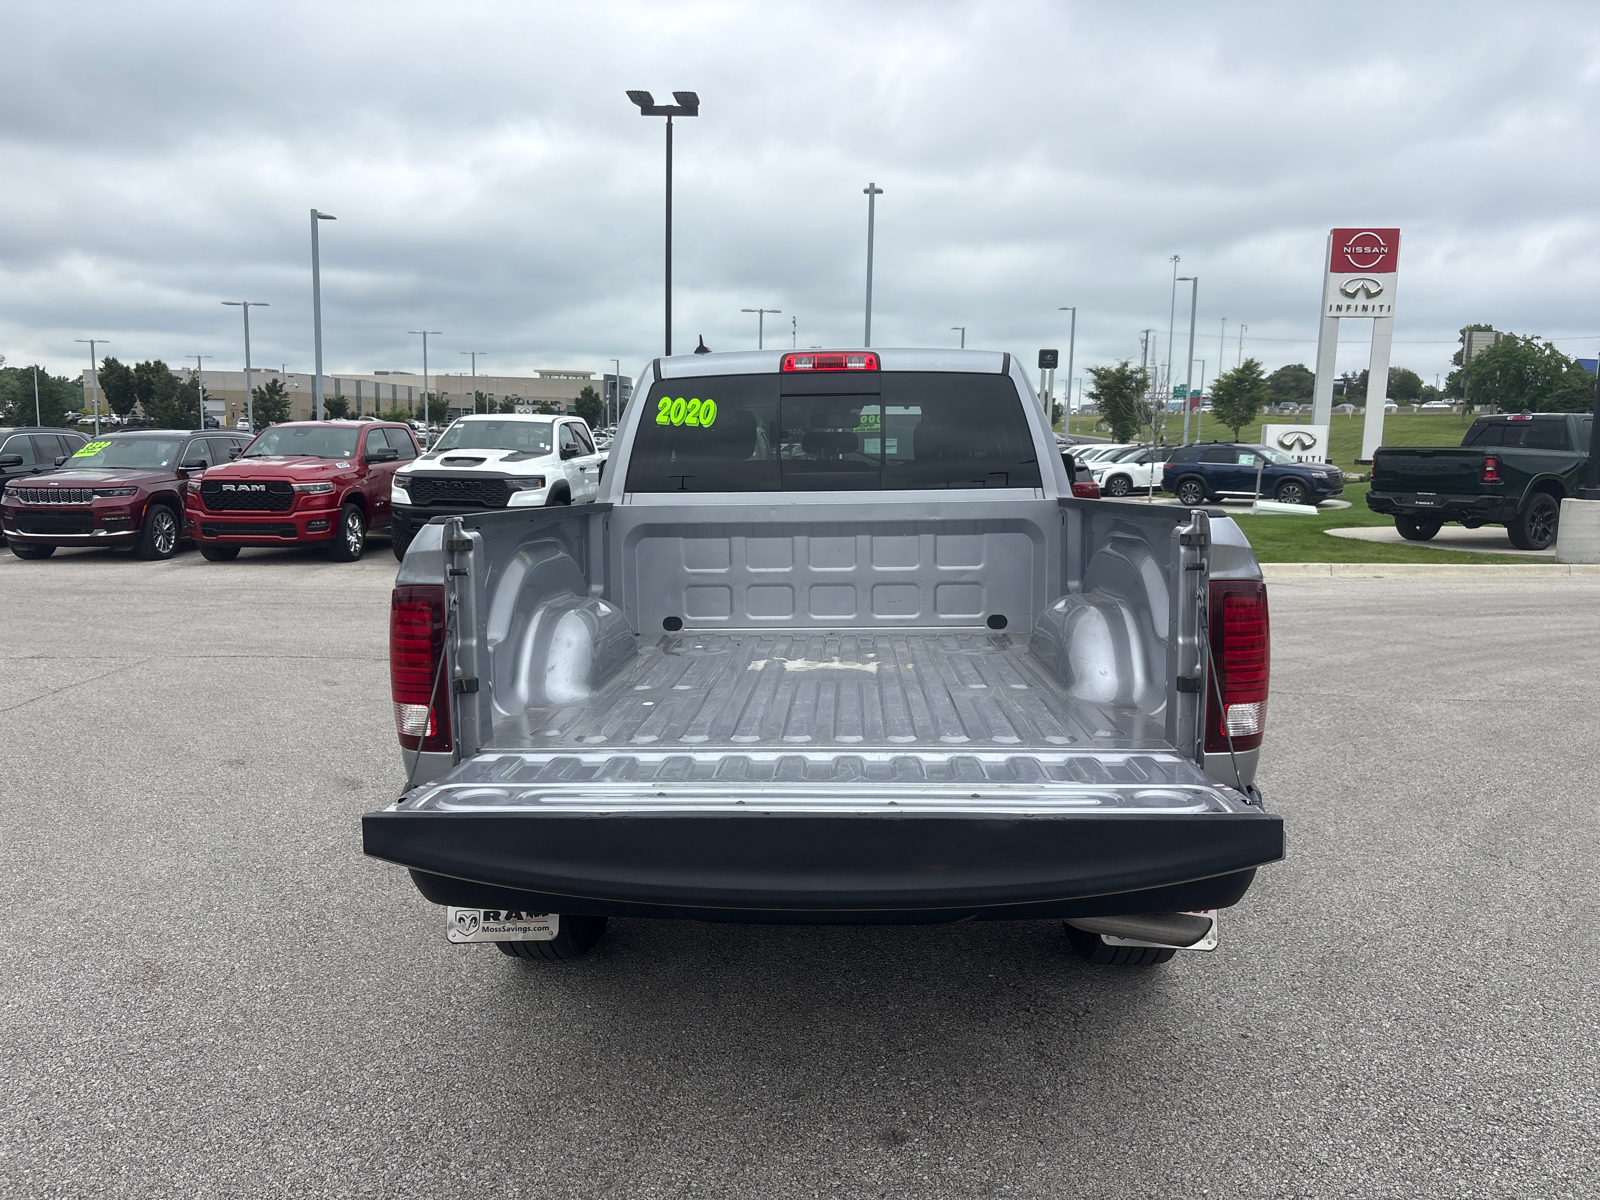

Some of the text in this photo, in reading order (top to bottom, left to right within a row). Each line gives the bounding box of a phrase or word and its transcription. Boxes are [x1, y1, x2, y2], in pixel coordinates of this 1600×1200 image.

[1343, 246, 1388, 254] NISSAN
[1329, 304, 1391, 312] INFINITI
[655, 396, 717, 428] 2020
[221, 484, 266, 492] RAM
[432, 480, 481, 489] RAM
[482, 925, 549, 933] MossSavings.com
